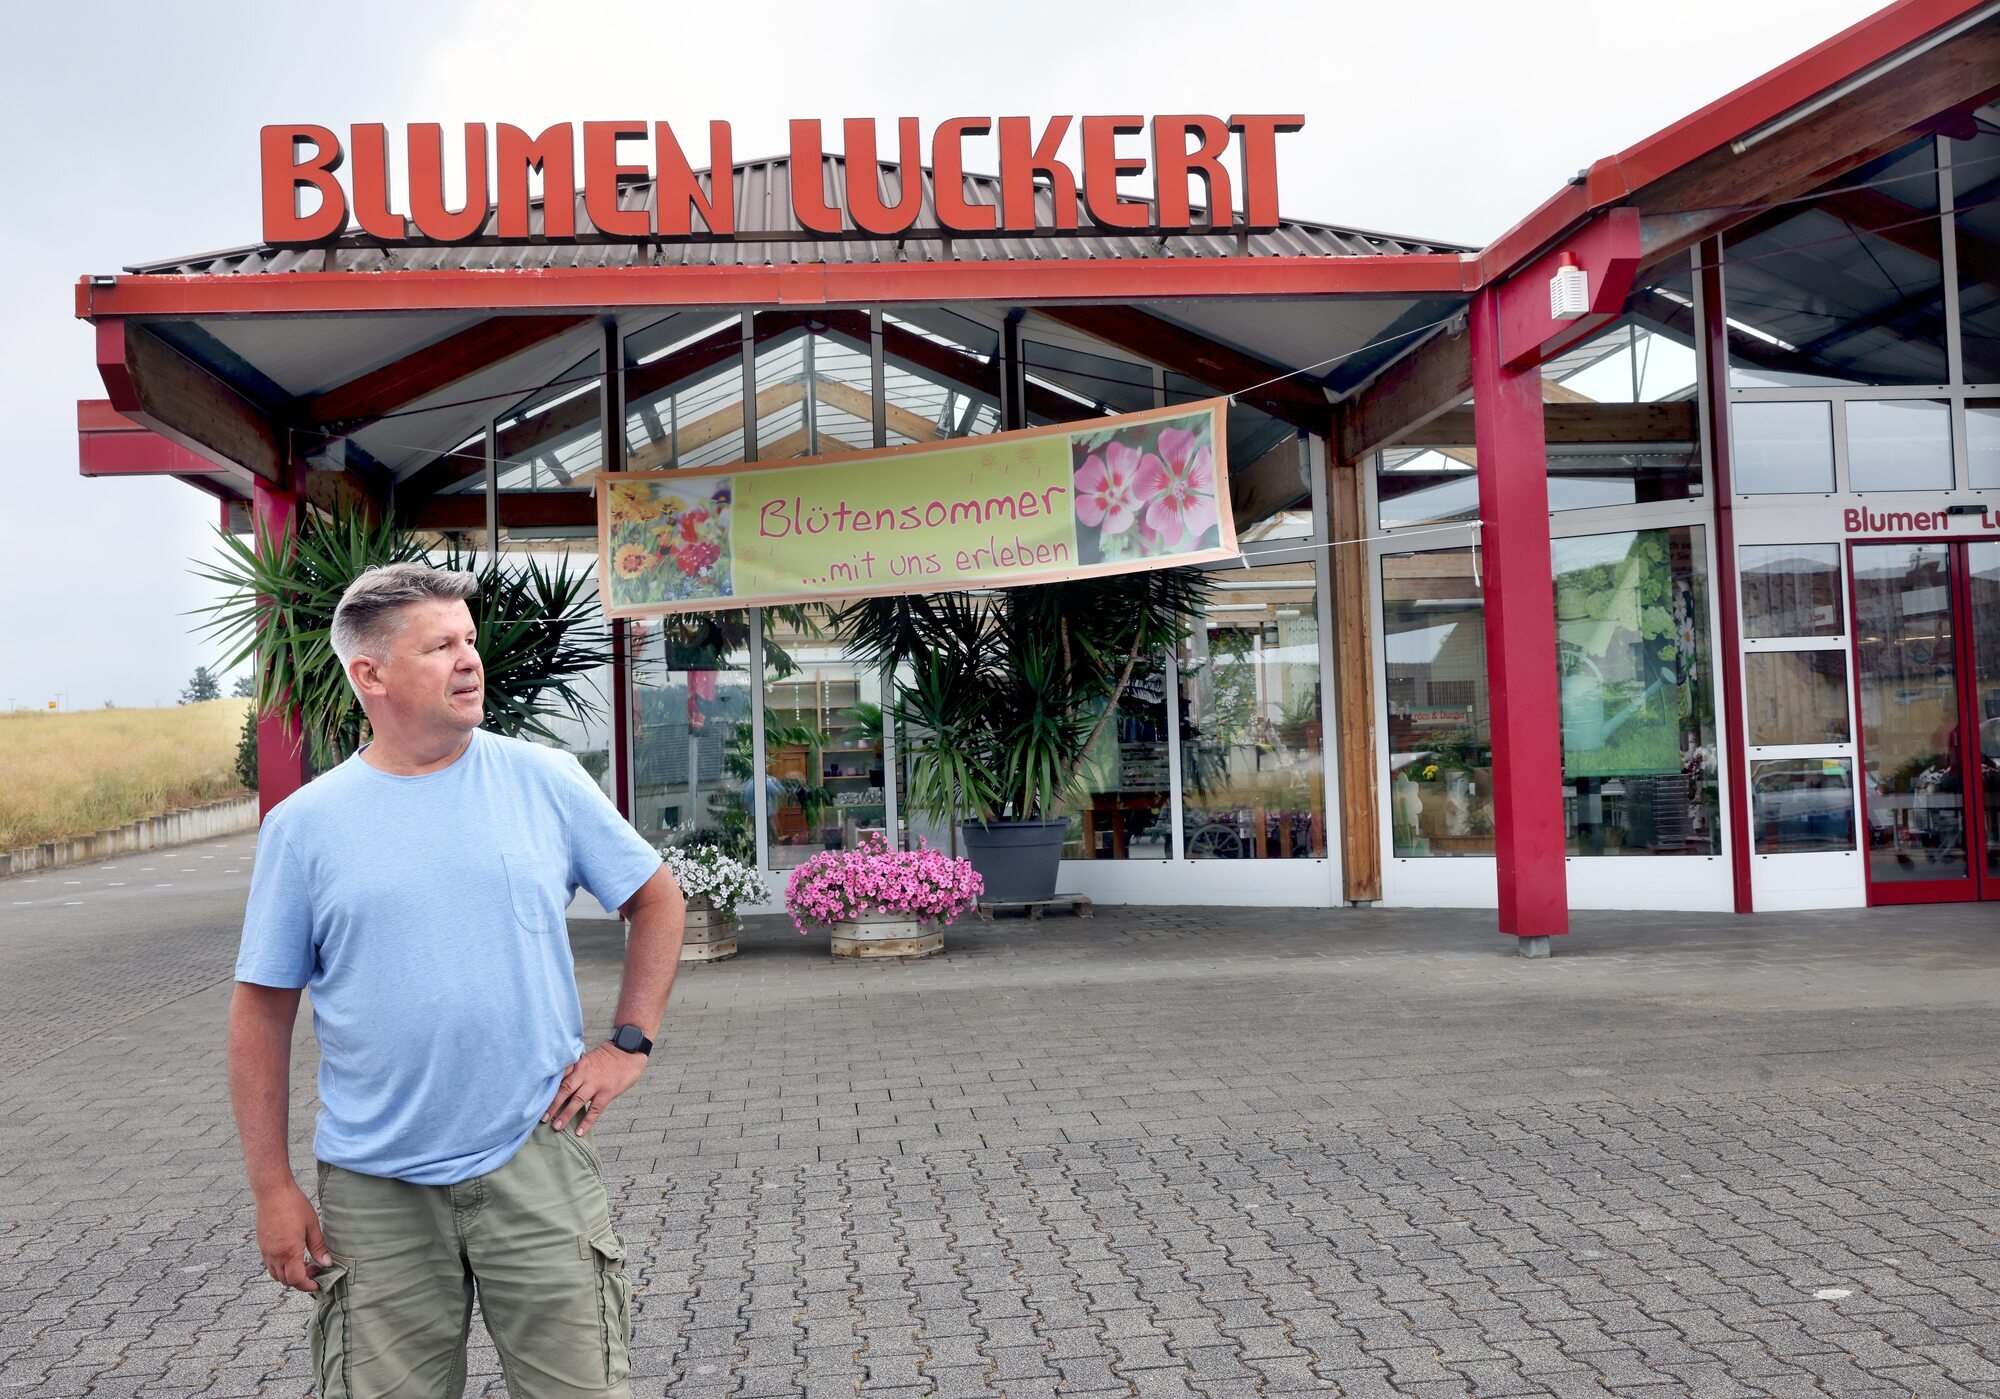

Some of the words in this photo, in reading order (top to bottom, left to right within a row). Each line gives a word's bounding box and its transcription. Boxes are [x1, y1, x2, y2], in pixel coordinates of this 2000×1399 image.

[260, 119, 735, 245] BLUMEN
[788, 114, 1306, 238] LUCKERT
[760, 486, 1066, 538] Blütensommer
[1843, 505, 1948, 533] Blumen
[801, 550, 876, 585] ...mit
[890, 552, 942, 576] uns
[956, 535, 1069, 572] erleben
[1410, 710, 1429, 720] rden
